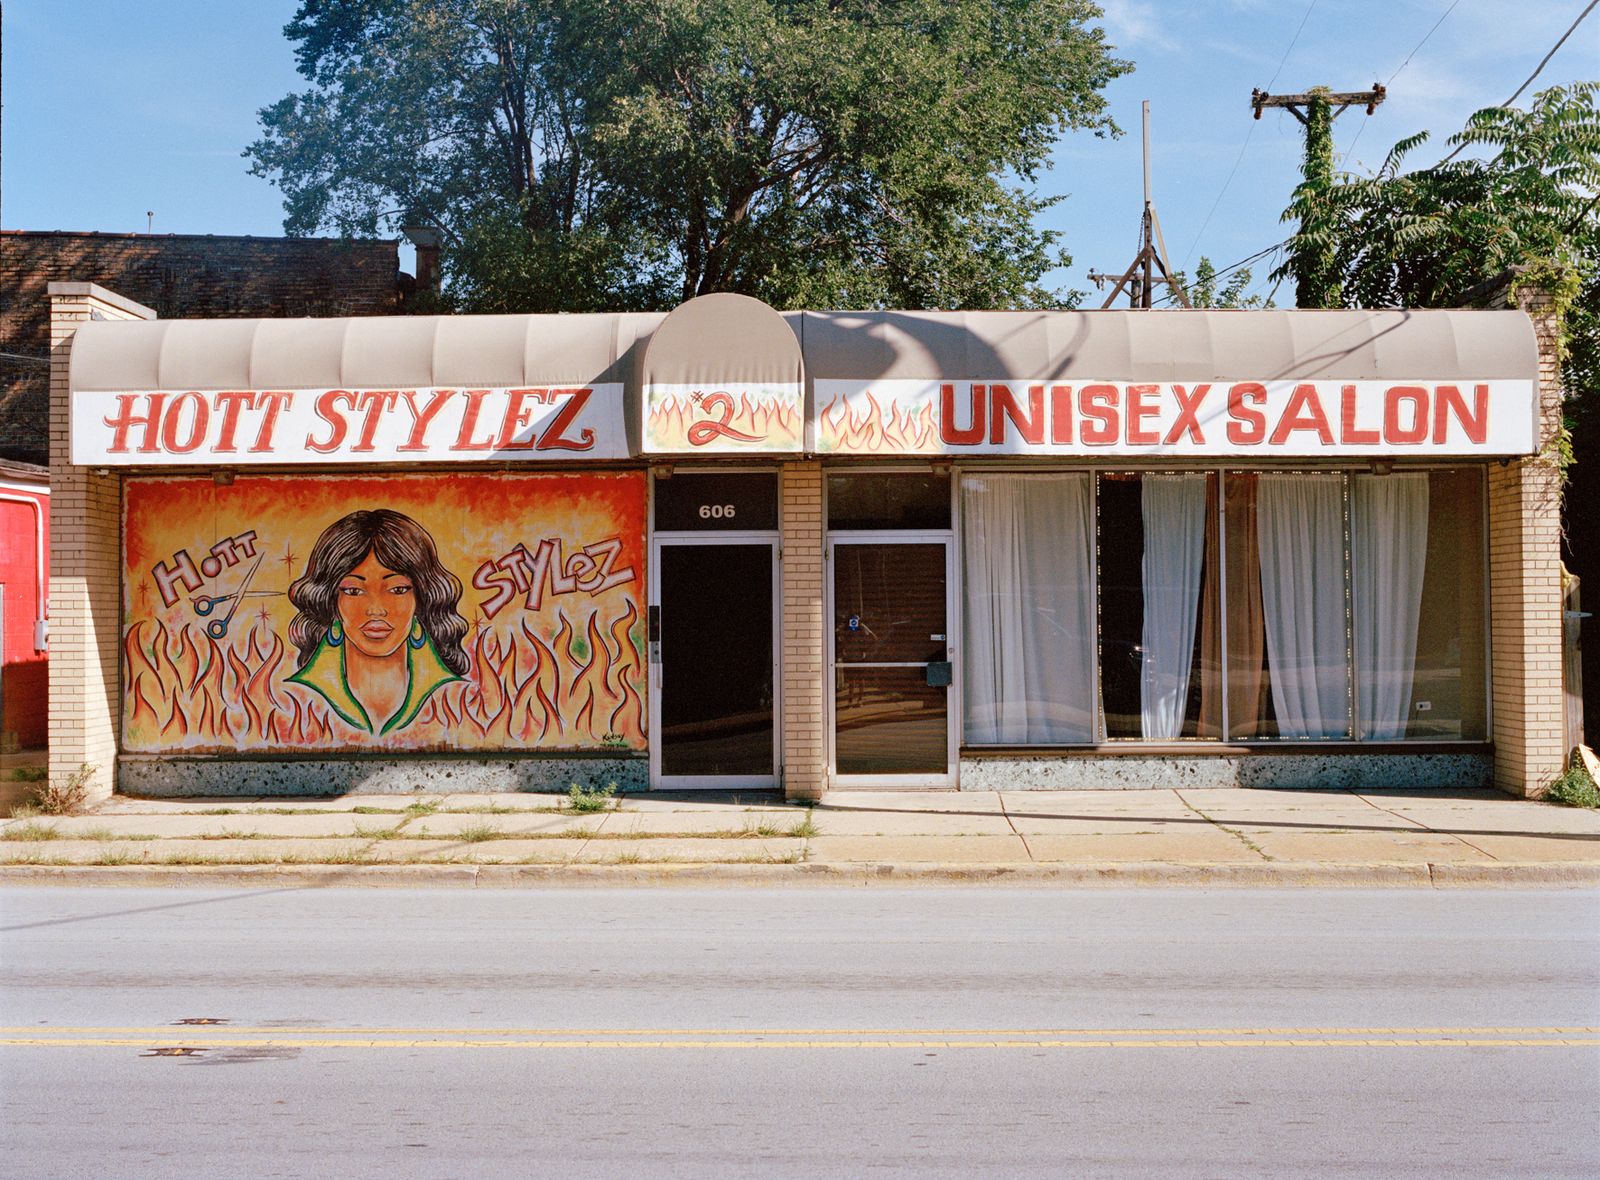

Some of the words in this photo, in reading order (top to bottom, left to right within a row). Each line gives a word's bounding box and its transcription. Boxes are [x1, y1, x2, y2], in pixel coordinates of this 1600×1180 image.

[103, 389, 292, 454] HOTT
[305, 388, 595, 454] STYLEZ
[938, 383, 1212, 446] UNISEX
[1226, 383, 1489, 446] SALON
[699, 504, 736, 519] 606
